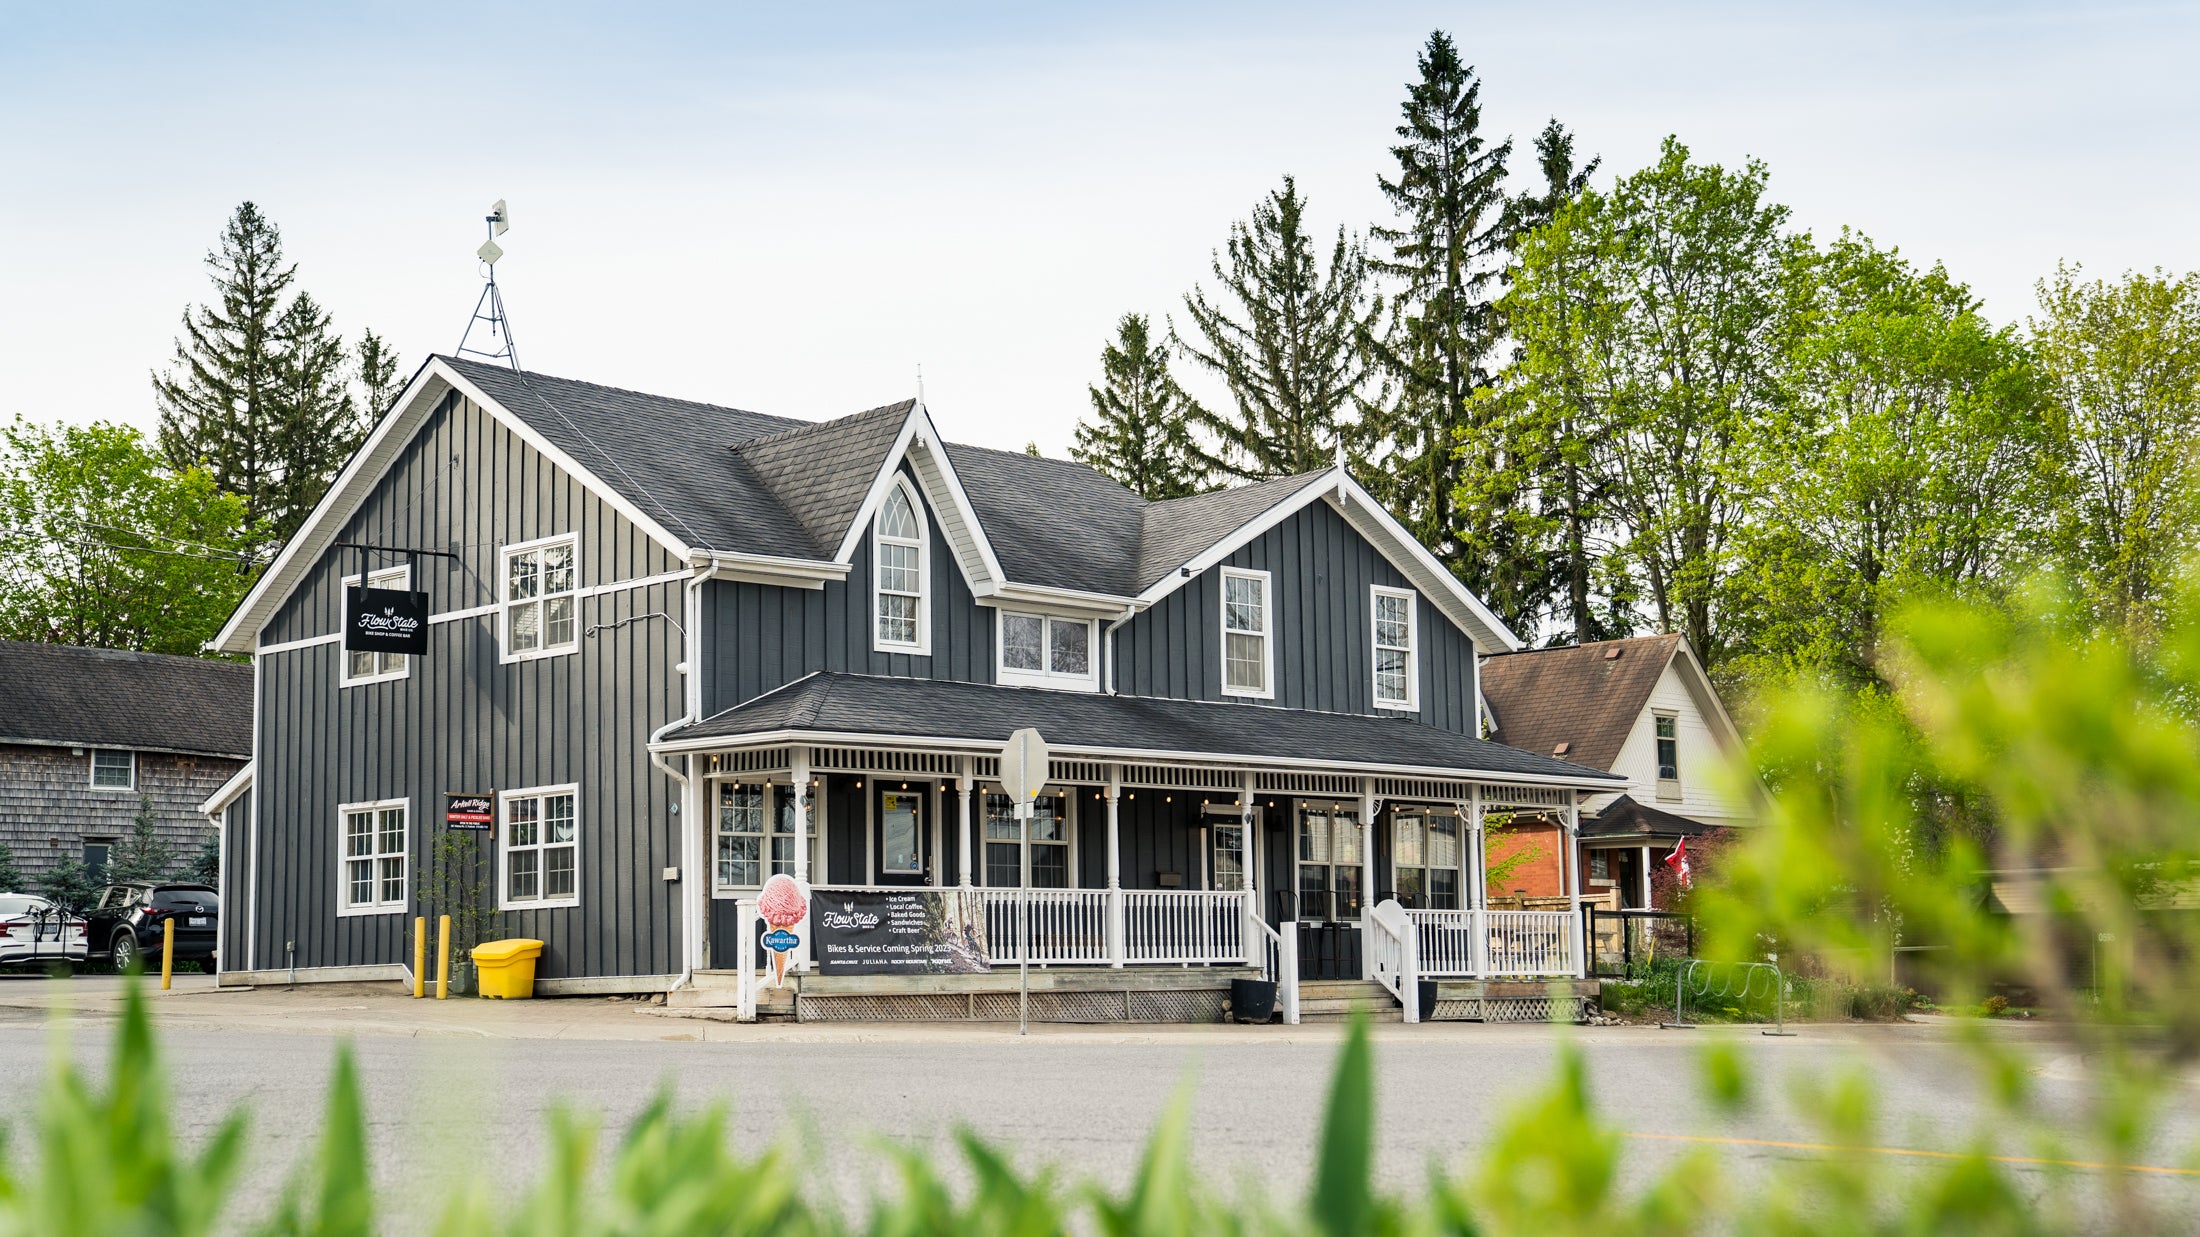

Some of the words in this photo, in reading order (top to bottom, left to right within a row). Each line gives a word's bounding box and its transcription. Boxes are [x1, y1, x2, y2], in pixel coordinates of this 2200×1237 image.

[451, 800, 472, 808] Arkell
[472, 799, 490, 810] Ridge
[766, 936, 798, 945] Kawartha
[827, 944, 846, 952] Bikes
[882, 944, 910, 954] Coming
[911, 944, 935, 954] Spring
